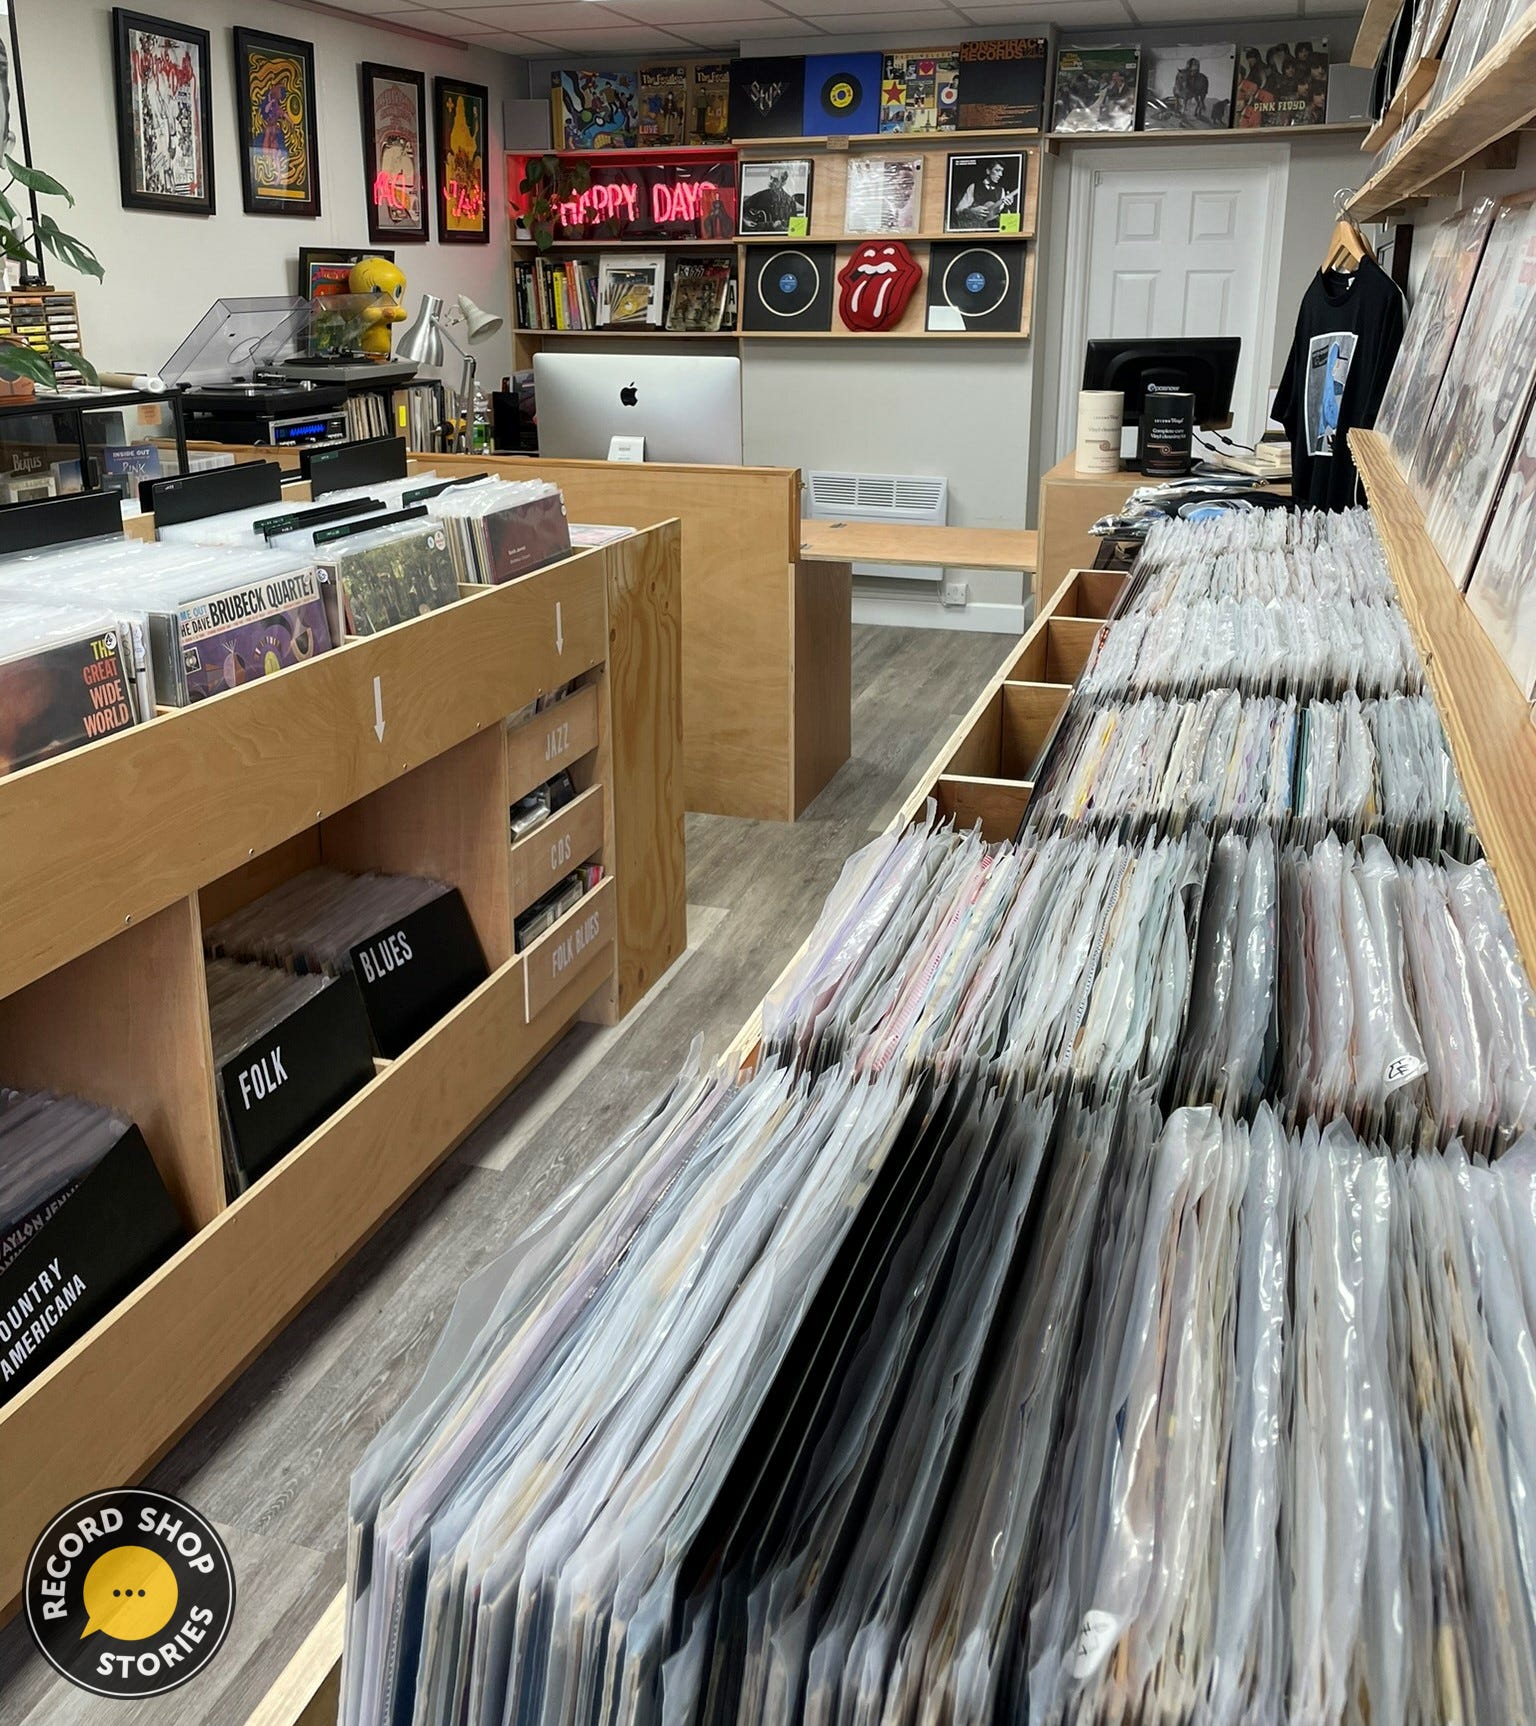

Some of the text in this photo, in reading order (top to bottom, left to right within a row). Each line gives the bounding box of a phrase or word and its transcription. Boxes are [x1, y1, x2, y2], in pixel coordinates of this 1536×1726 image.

[960, 49, 1023, 61] RECORDS
[1253, 102, 1275, 112] PINK
[652, 181, 717, 224] DAY
[179, 609, 192, 621] ME
[181, 619, 192, 638] HE
[192, 616, 212, 634] DAVE
[208, 587, 267, 627] BRUBECK
[82, 657, 118, 686] GREAT
[89, 679, 125, 710] WIDE
[83, 702, 129, 738] WORLD
[544, 721, 570, 761] JAZZ
[550, 833, 572, 871] CDS
[358, 930, 413, 984] BLUES
[551, 910, 600, 979] FOLK BLUES
[238, 1045, 289, 1111] FOLK
[0, 1213, 44, 1258] AYLON
[0, 1256, 63, 1343] OUNTRY
[0, 1273, 87, 1383] AMERICANA
